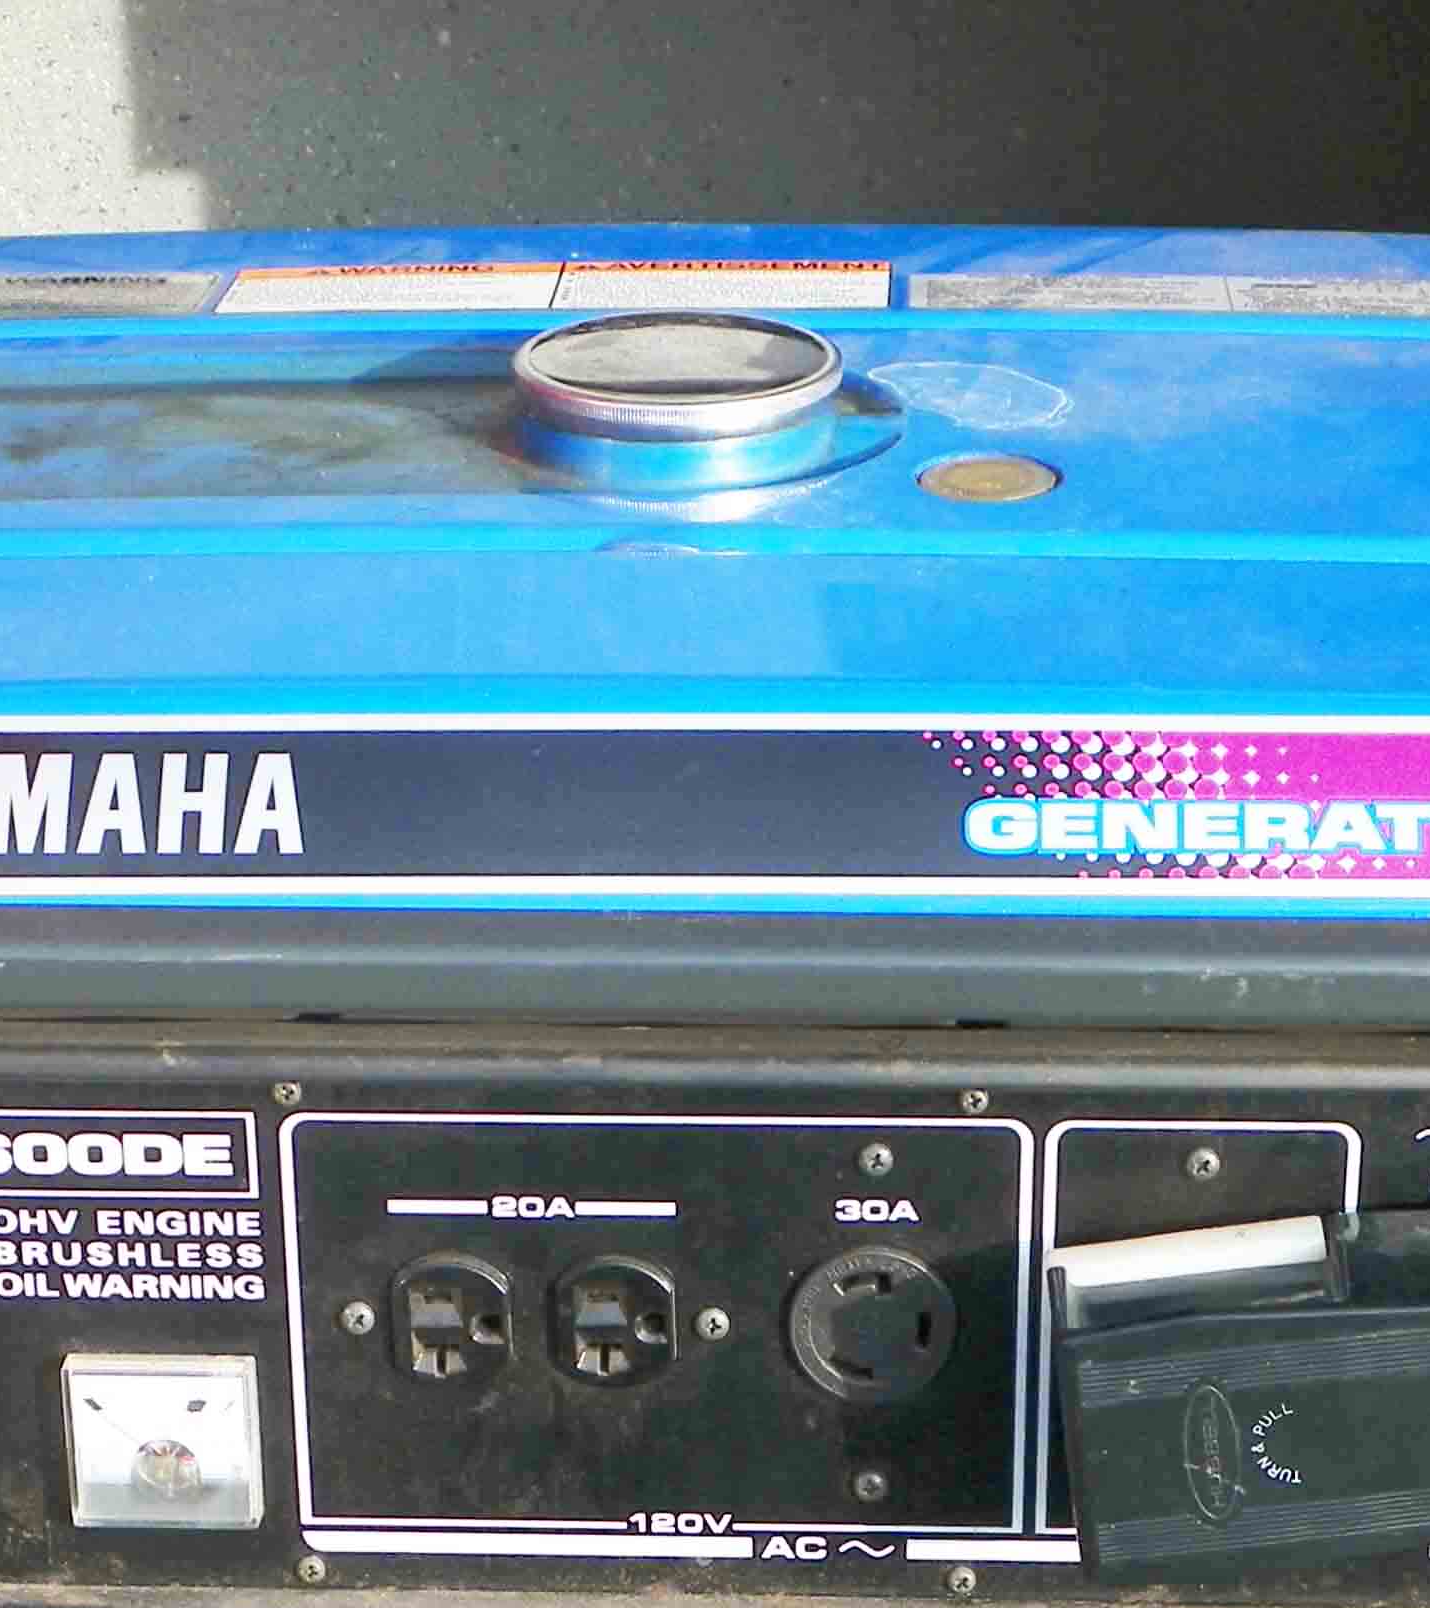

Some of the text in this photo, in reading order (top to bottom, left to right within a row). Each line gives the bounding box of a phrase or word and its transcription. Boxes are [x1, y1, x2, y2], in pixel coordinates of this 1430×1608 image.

[339, 263, 495, 274] WARNING
[491, 1196, 575, 1218] 20A
[835, 1199, 919, 1222] 30A
[96, 1210, 261, 1237] ENGINE
[63, 1273, 265, 1300] WARNING
[1250, 1403, 1302, 1484] TURN & PULL
[628, 1512, 733, 1534] 120V
[761, 1536, 827, 1560] AC
